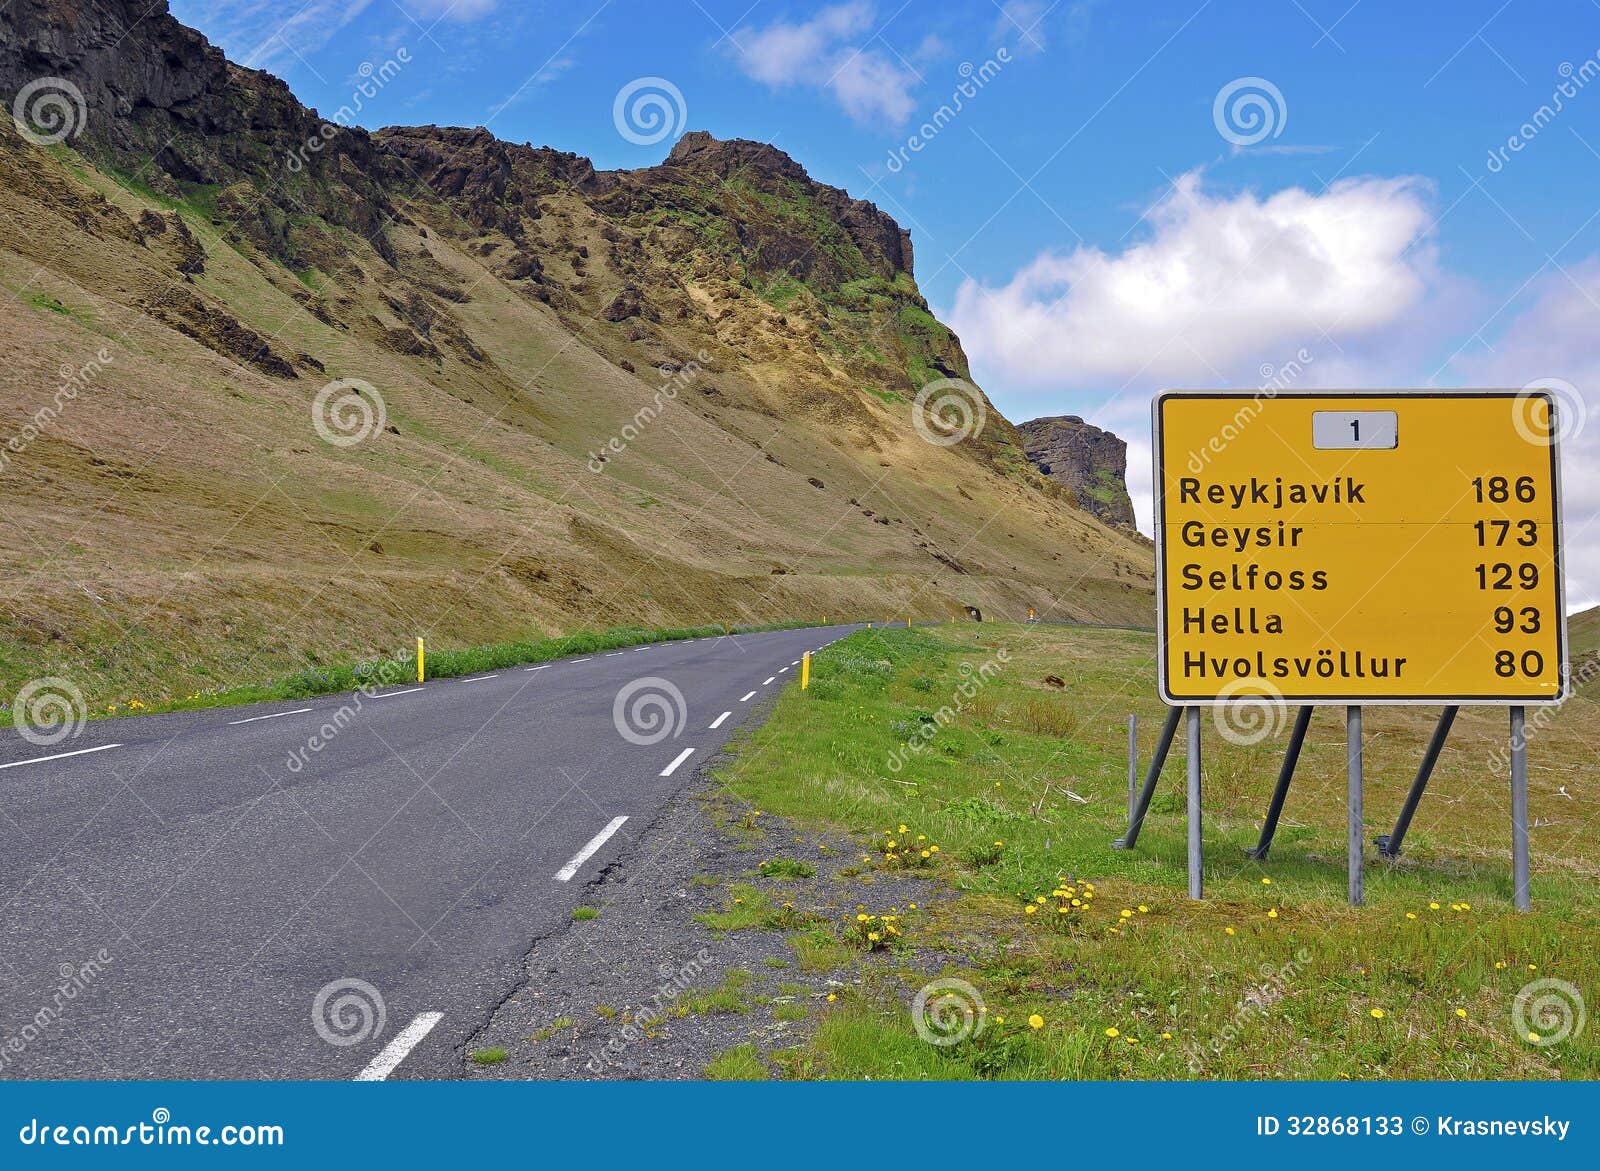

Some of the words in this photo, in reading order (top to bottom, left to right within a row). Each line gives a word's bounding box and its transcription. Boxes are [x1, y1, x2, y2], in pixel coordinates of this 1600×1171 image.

[1348, 419, 1360, 442] 1
[1180, 477, 1365, 510] Reykjavík
[1471, 476, 1536, 504] 186
[1181, 520, 1304, 553] Geysir
[1473, 519, 1538, 547] 173
[1181, 563, 1328, 591] Selfoss
[1475, 562, 1539, 590] 129
[1183, 607, 1283, 635] Hella
[1493, 606, 1541, 634] 93
[1184, 649, 1407, 678] Hvolsvöllur
[1495, 650, 1544, 678] 80
